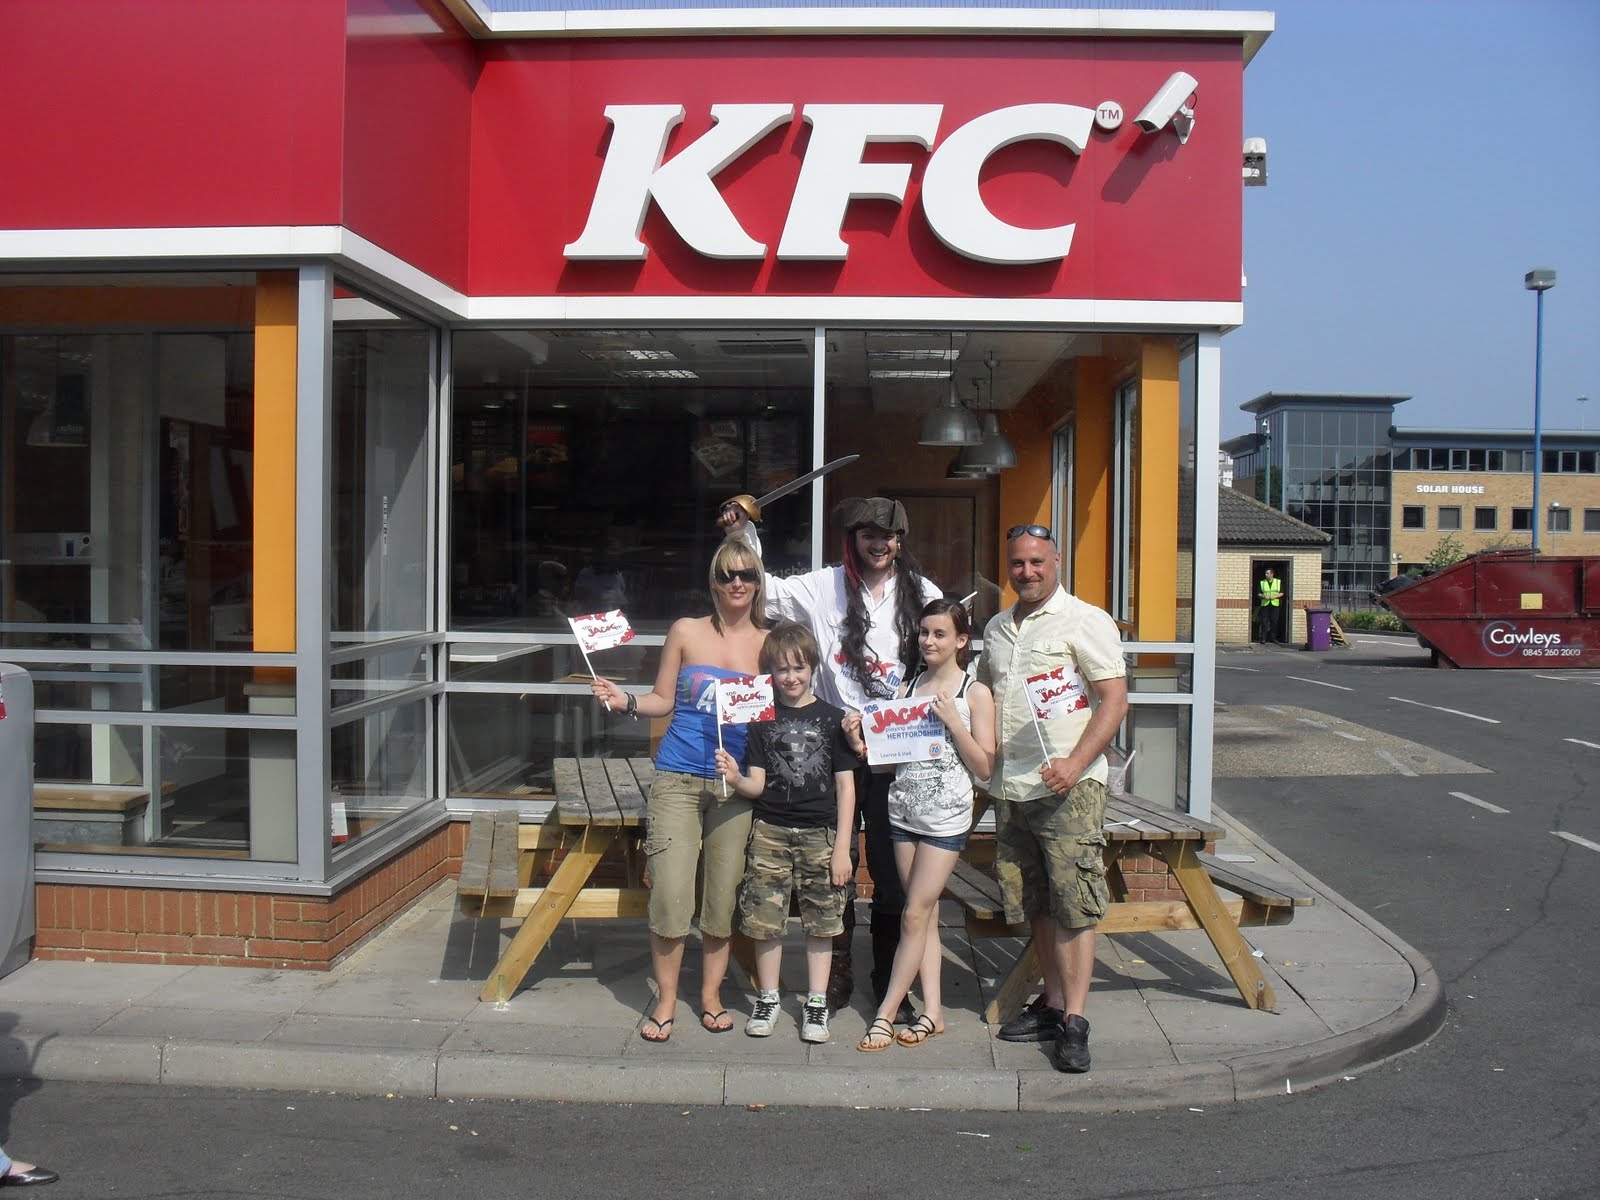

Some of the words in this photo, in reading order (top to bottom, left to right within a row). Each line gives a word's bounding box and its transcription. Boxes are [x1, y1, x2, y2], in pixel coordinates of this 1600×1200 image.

[1098, 109, 1120, 120] TM
[563, 102, 1096, 264] KFC
[1416, 484, 1449, 493] SOLAR
[1451, 485, 1485, 494] HOUSE
[588, 623, 615, 637] JACK
[1490, 627, 1561, 648] Cawleys
[1522, 648, 1543, 657] 0845
[1544, 648, 1559, 657] 260
[1560, 648, 1581, 657] 2000
[729, 691, 760, 706] JACK
[1041, 680, 1072, 704] JACK
[863, 703, 879, 715] 106
[870, 701, 930, 734] JACK
[887, 728, 943, 740] HERTFORDSHIRE
